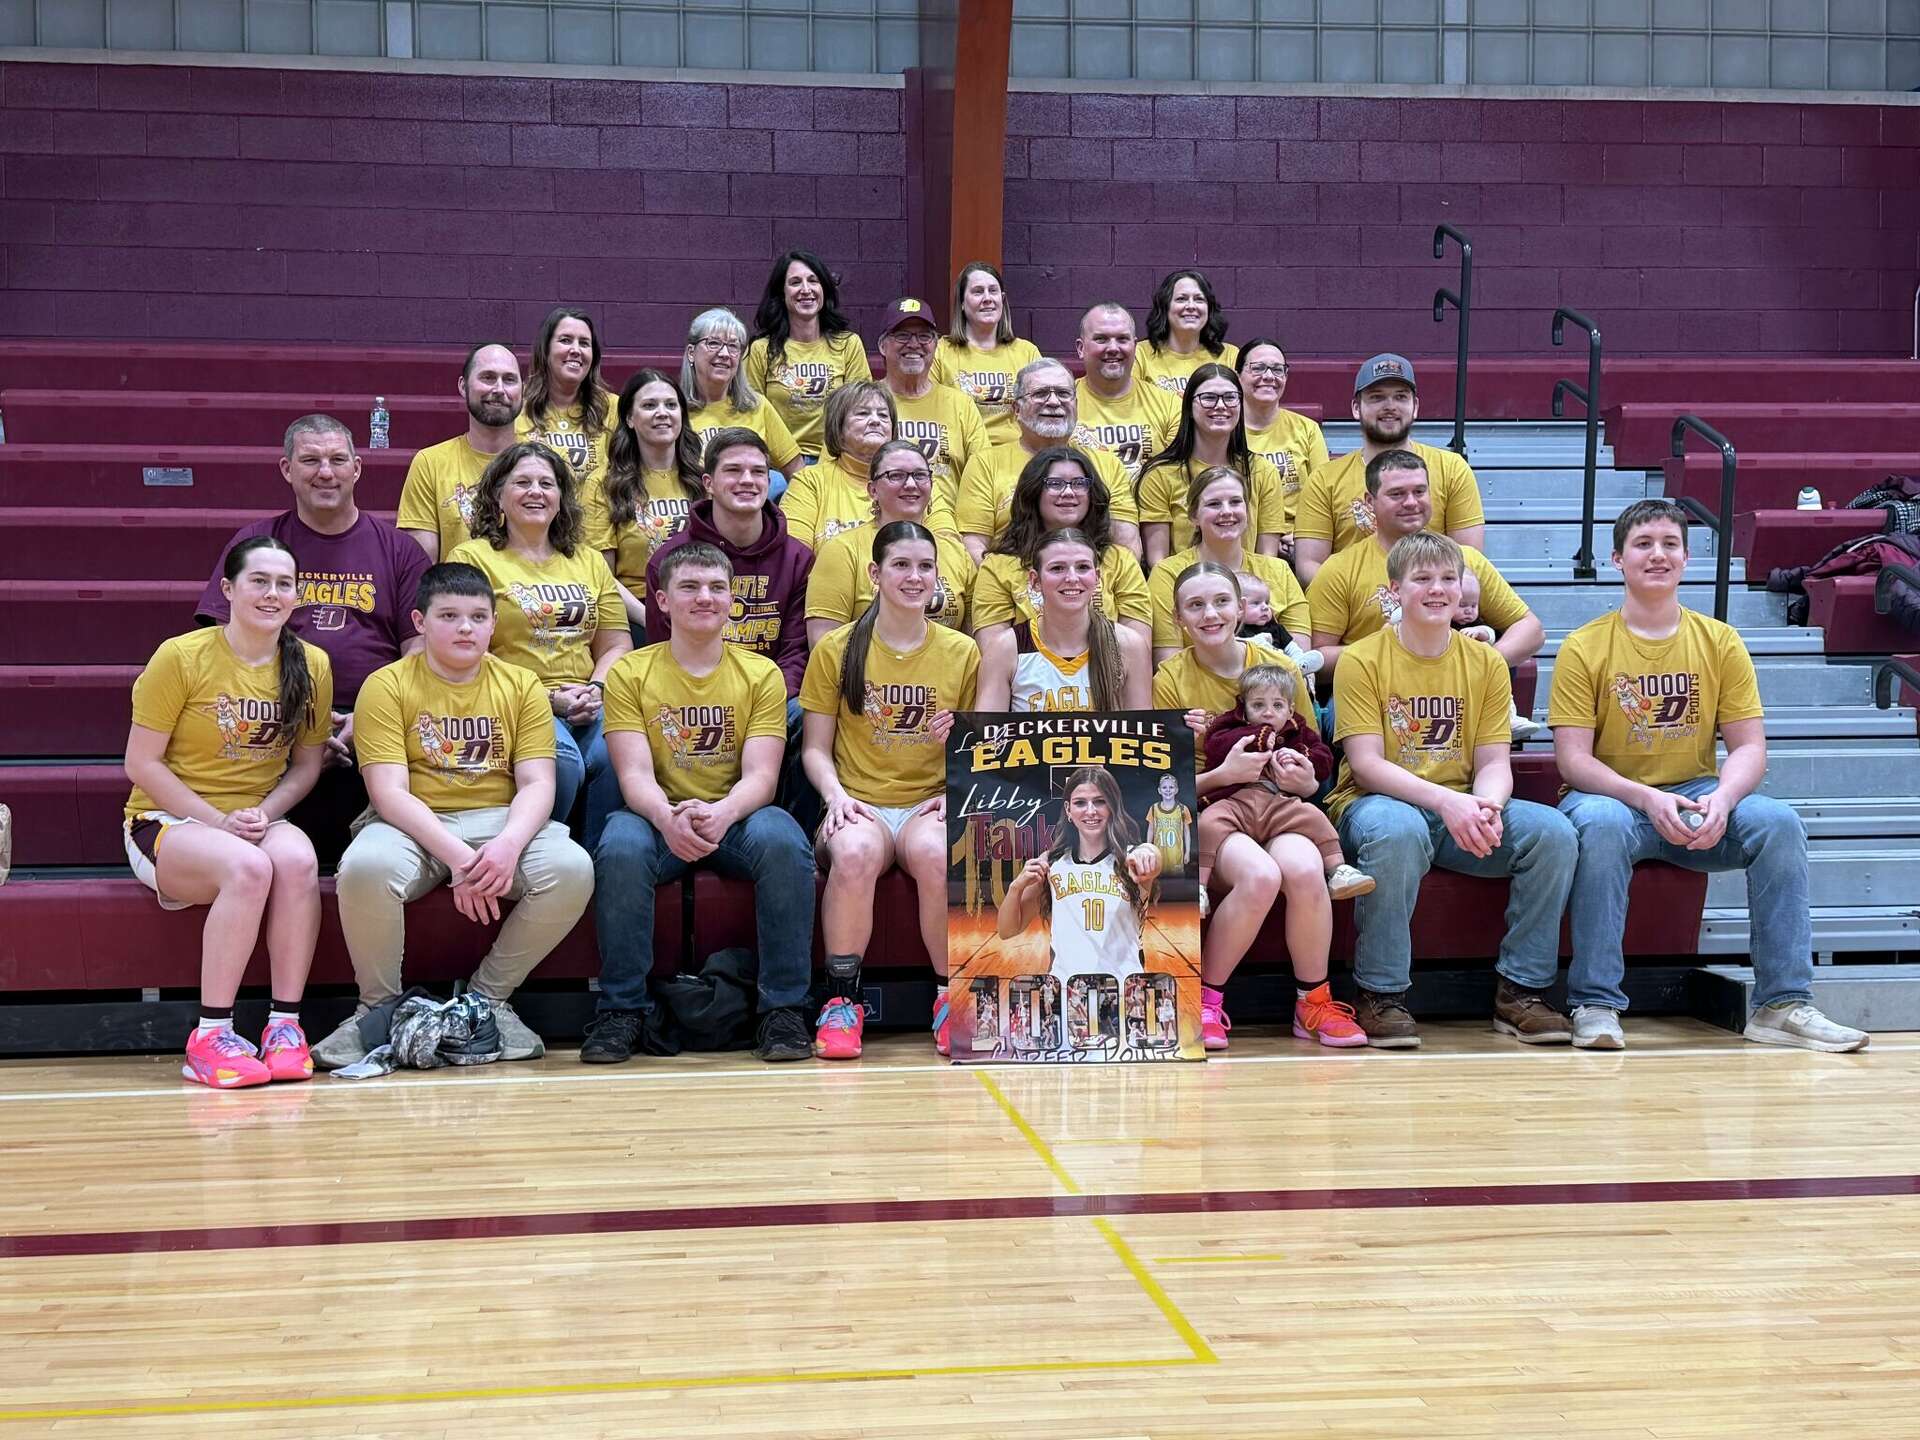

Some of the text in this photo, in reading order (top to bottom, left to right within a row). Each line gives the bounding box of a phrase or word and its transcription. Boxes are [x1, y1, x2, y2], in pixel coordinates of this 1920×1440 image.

[795, 363, 827, 378] 1000
[974, 372, 1006, 386] 1000
[547, 433, 588, 448] 1000
[898, 421, 939, 440] 1000
[1096, 425, 1141, 446] 1000
[650, 499, 690, 517] 1000
[298, 571, 374, 581] ECKERVILLE
[730, 575, 770, 600] ATE
[533, 584, 586, 602] 1000
[721, 616, 782, 643] AMPS
[882, 684, 927, 706] 1000
[1638, 672, 1690, 698] 1000
[1689, 672, 1701, 715] POINTS
[238, 699, 282, 722] 1000
[680, 705, 725, 728] 1000
[1409, 696, 1456, 720] 1000
[443, 716, 492, 741] 1000
[724, 705, 736, 744] POINTS
[984, 718, 1165, 741] DECKERVILLE
[490, 717, 506, 760] POINTS
[970, 736, 1171, 773] EAGLES
[957, 783, 1050, 828] Libby
[1082, 898, 1104, 932] 10
[969, 973, 1178, 1053] 1000
